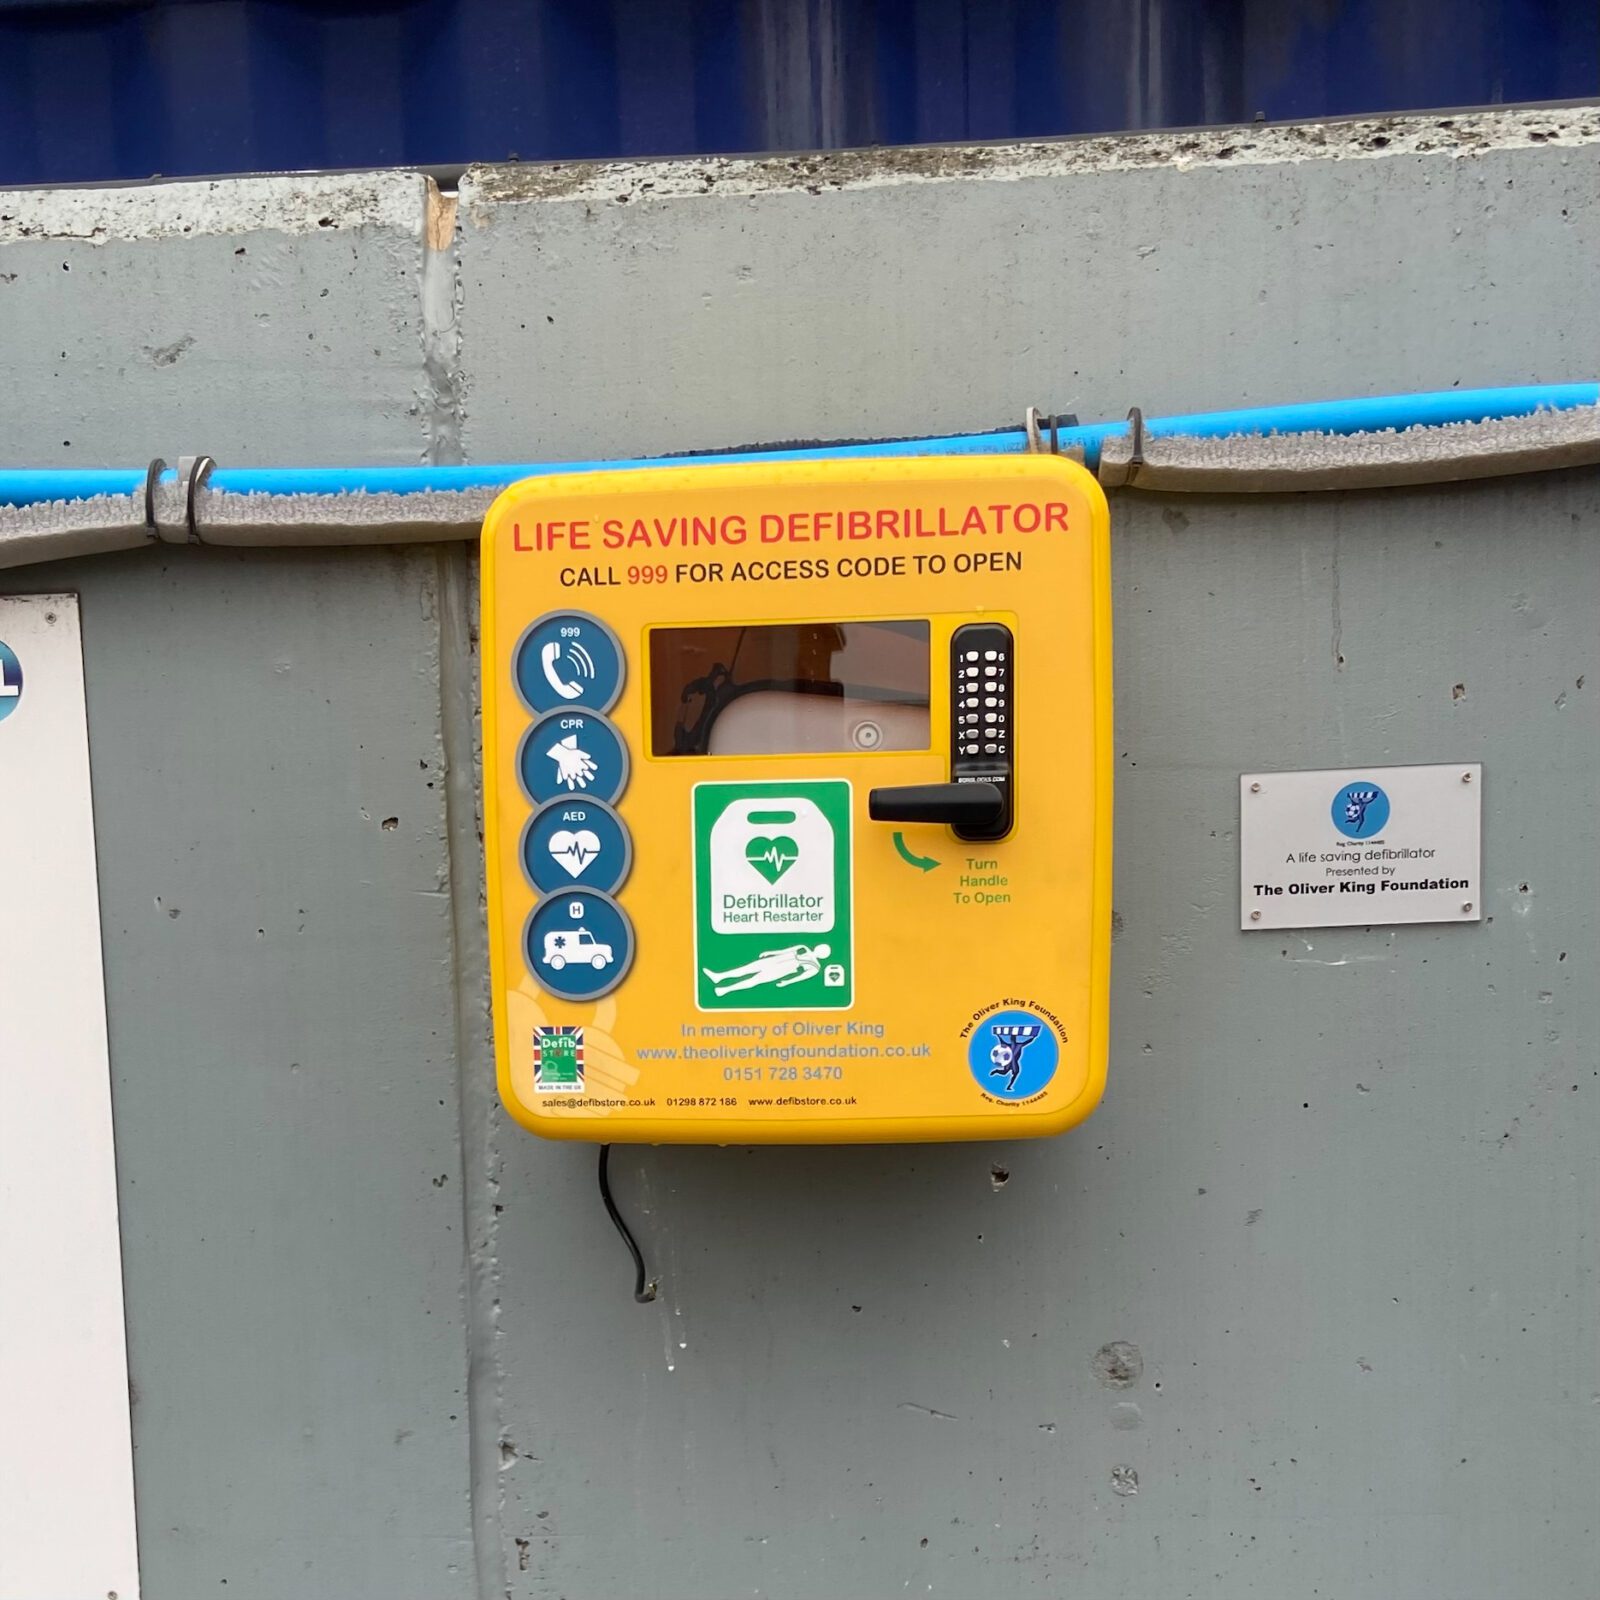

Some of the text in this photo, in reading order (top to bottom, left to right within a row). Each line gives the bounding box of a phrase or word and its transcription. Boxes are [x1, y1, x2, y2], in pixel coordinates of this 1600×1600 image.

[513, 502, 1069, 552] LIFE SAVING DEFIBRILLATOR
[560, 551, 1022, 588] CALL 999 FOR ACCESS CODE TO OPEN
[560, 627, 581, 638] 999
[560, 719, 584, 730] CPR
[562, 811, 587, 822] AED
[1286, 848, 1436, 864] A life saving defibrillator
[966, 858, 998, 870] Turn
[1326, 866, 1396, 877] Presented by
[960, 874, 1008, 887] Handle
[1254, 878, 1469, 896] The Oliver King Foundation
[723, 893, 824, 909] Defibrillator
[954, 892, 1011, 906] To Open
[572, 905, 581, 915] H
[723, 910, 824, 923] Heart Restarter
[960, 997, 1069, 1044] The Oliver King Foundation
[681, 1021, 885, 1039] In memory of Oliver King
[542, 1037, 576, 1048] Defib
[637, 1043, 931, 1061] www.theoliverkingfoundation.co.uk
[723, 1066, 843, 1081] 0151 728 3470
[542, 1095, 857, 1109] sales@defibstore.co.uk 01298 872 186 www.defibstore.co.uk
